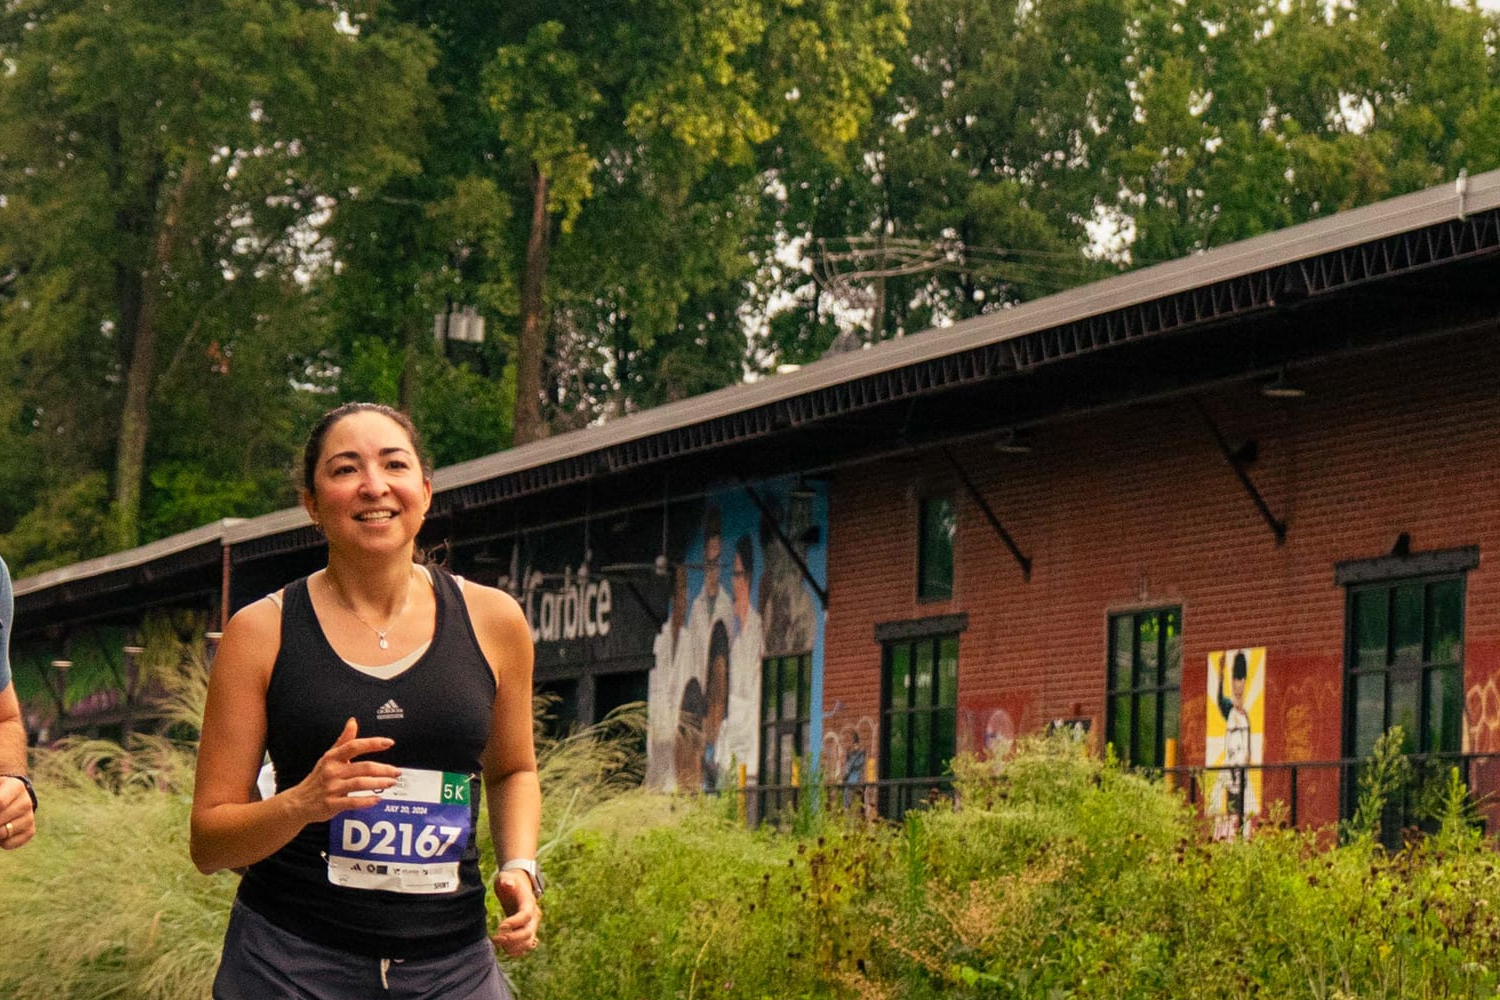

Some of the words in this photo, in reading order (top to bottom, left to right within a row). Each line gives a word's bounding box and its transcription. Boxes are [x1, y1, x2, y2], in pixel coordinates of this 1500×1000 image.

[525, 566, 612, 643] Carbice
[443, 783, 464, 801] 5K
[384, 804, 399, 813] JULY
[411, 806, 428, 815] 2024
[342, 818, 462, 859] D2167
